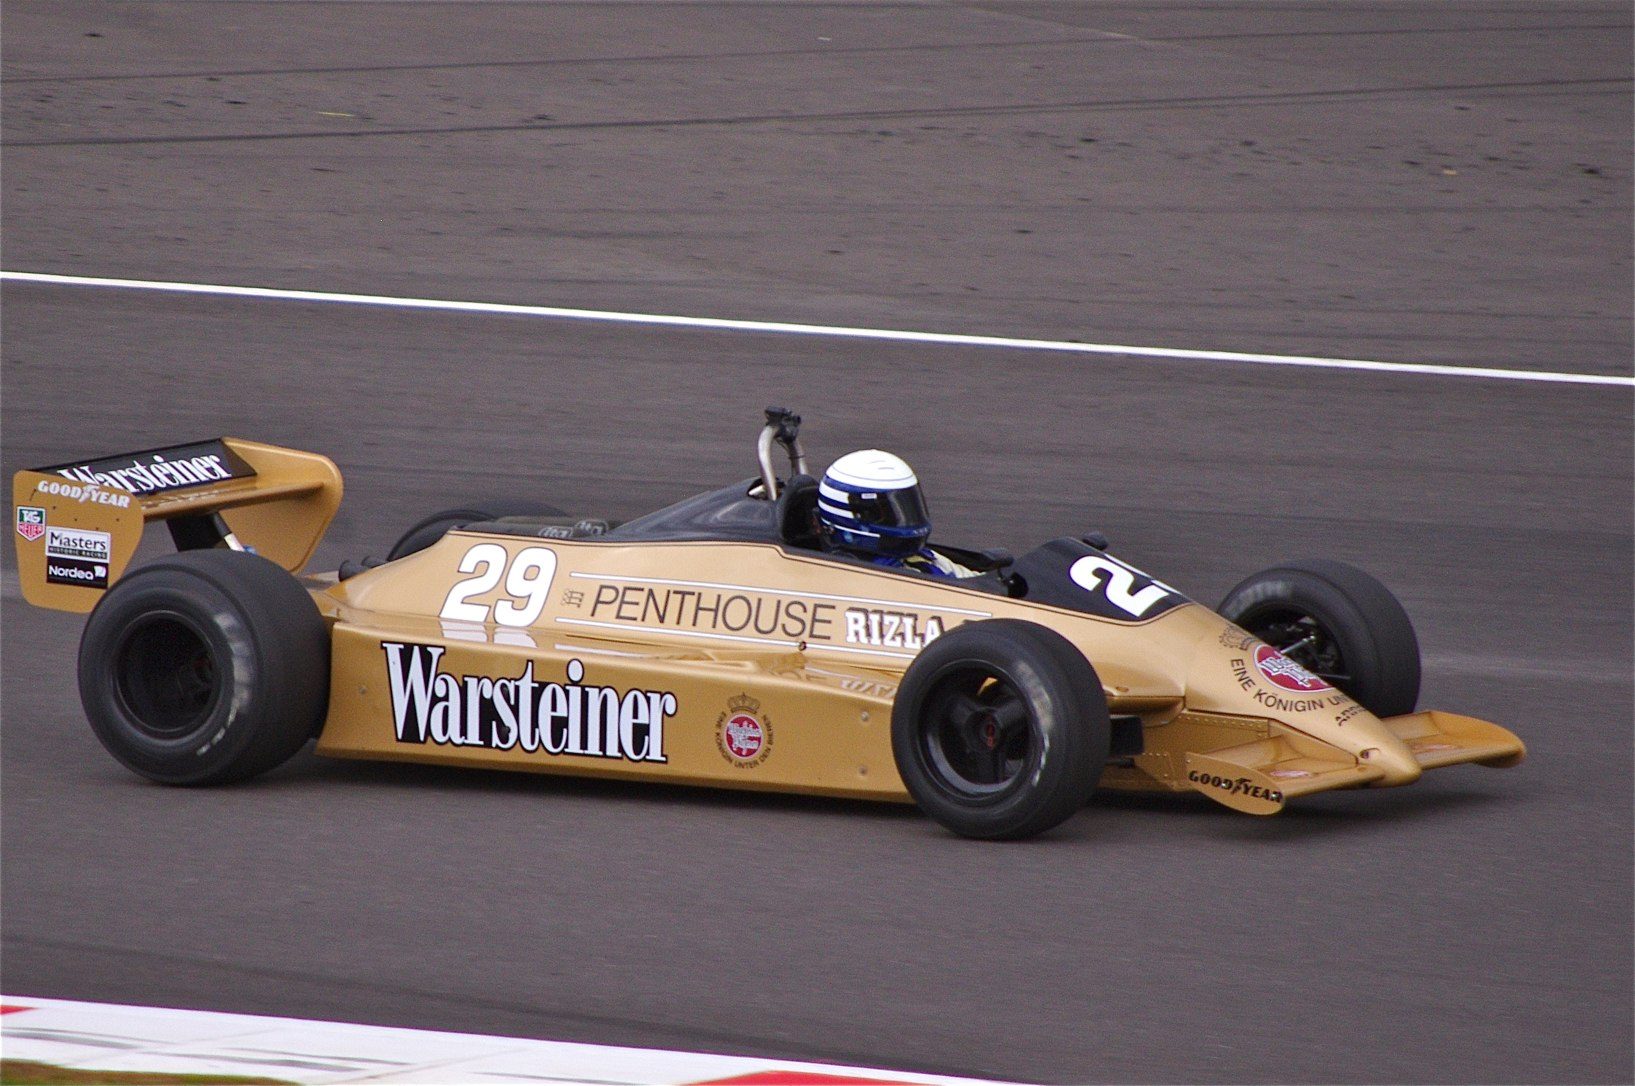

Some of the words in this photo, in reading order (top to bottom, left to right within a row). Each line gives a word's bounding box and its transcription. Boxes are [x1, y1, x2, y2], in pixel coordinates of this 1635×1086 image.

[57, 454, 232, 493] Warsteiner
[37, 480, 130, 508] GOODYEAR
[18, 523, 43, 537] HEUER
[21, 510, 41, 523] TAG
[49, 531, 106, 551] Masters
[48, 564, 94, 581] Nordea
[438, 543, 557, 627] 29
[1069, 555, 1171, 617] 2
[590, 585, 836, 640] PENTHOUSE
[845, 607, 945, 650] RIZLA
[381, 641, 677, 763] Warsteiner
[1230, 658, 1256, 691] EINE
[1253, 689, 1325, 712] KÖNIGIN
[1188, 770, 1284, 803] GOODYEAR
